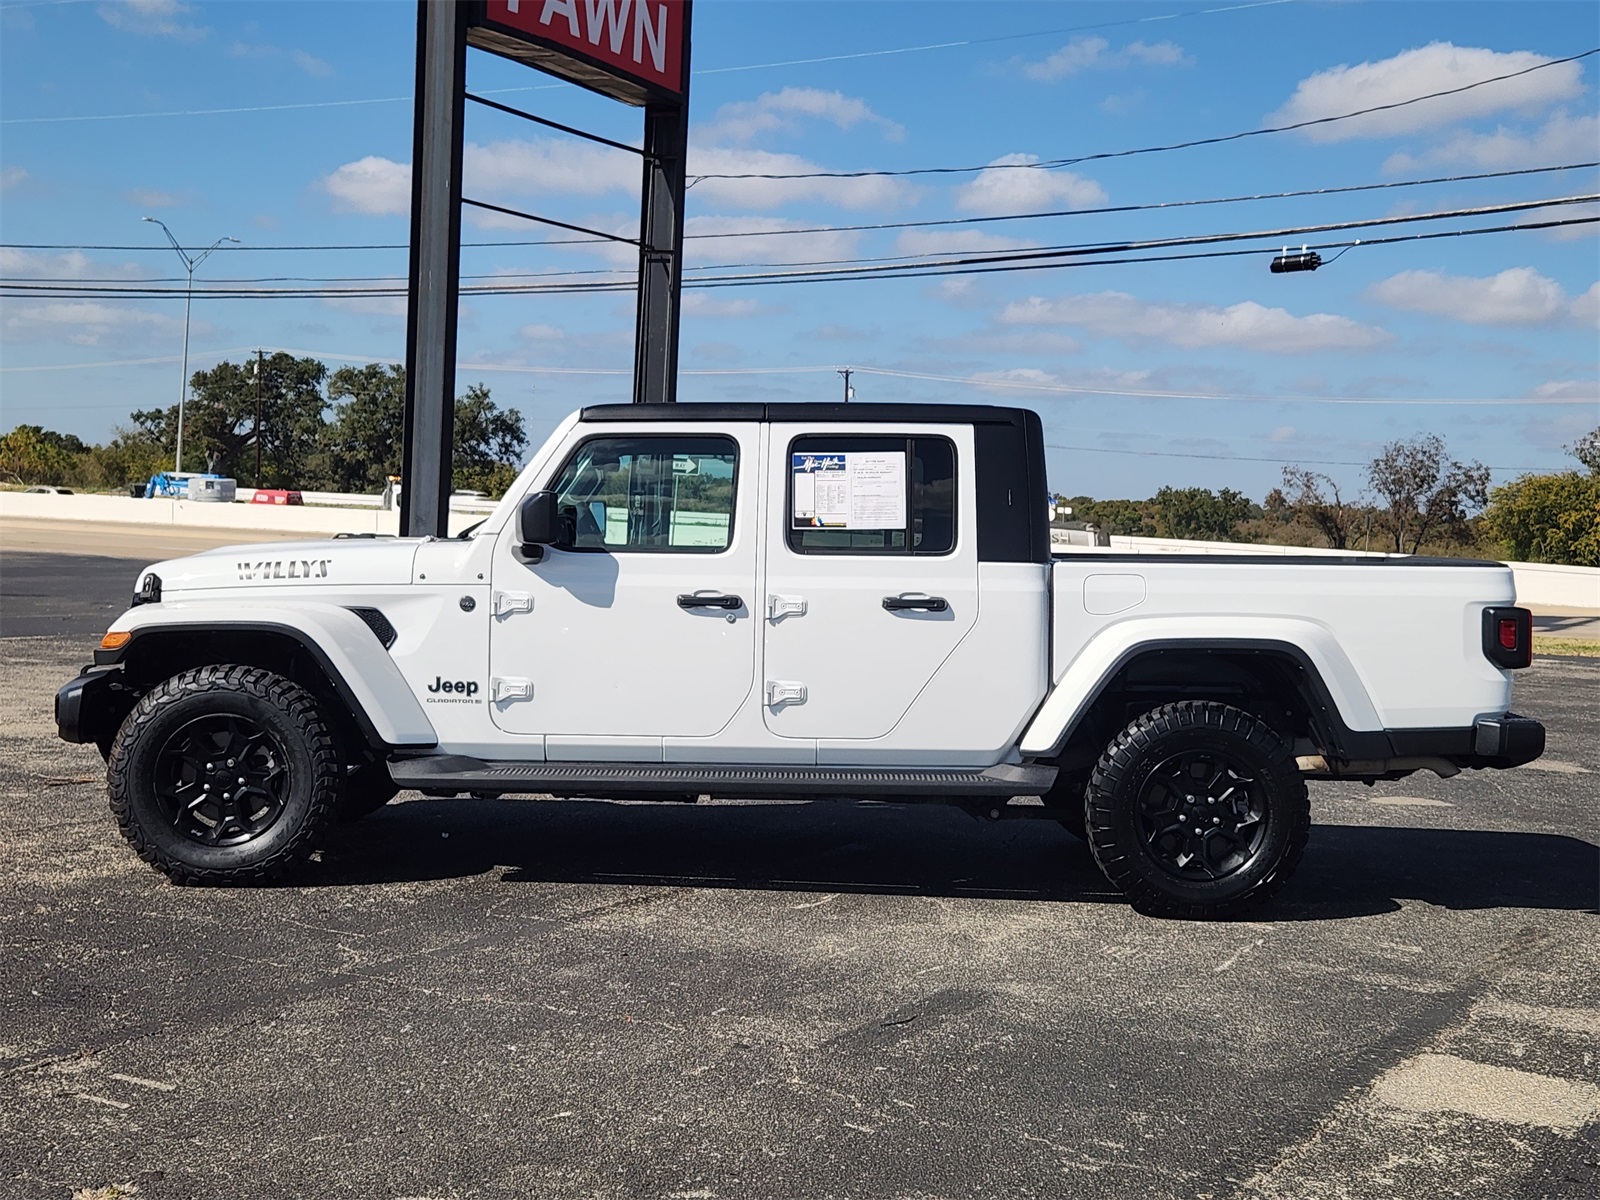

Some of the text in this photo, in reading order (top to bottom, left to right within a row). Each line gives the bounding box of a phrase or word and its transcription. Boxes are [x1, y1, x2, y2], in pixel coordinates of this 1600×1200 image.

[506, 0, 668, 73] AWN
[237, 559, 332, 580] WILLYS
[427, 676, 479, 697] Jeep
[426, 697, 474, 705] GLADIATOR
